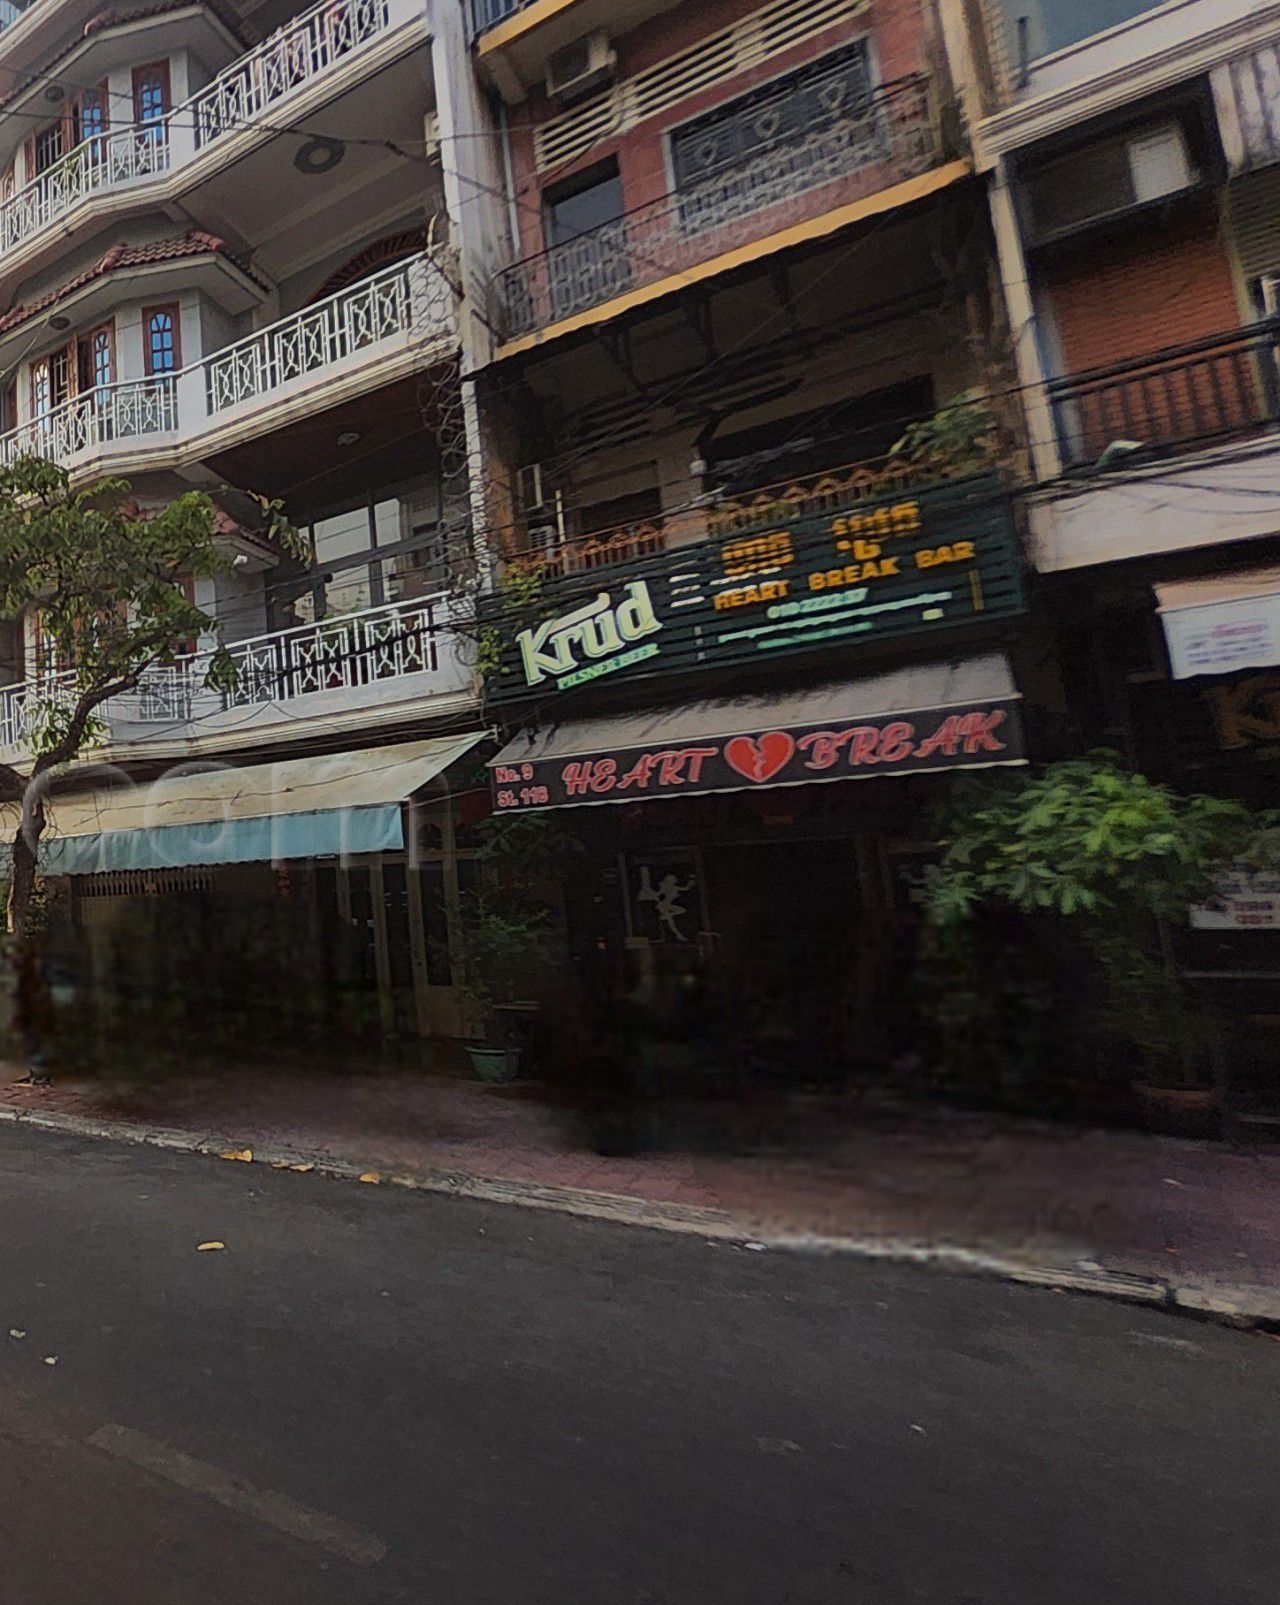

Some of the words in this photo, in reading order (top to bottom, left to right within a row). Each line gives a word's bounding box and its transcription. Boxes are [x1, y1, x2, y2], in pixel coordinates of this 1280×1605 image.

[714, 580, 791, 609] HEART
[808, 556, 902, 591] BREAK
[914, 541, 976, 569] BAR
[520, 763, 534, 781] 9
[561, 746, 719, 795] HEART
[796, 709, 1007, 769] BREAK
